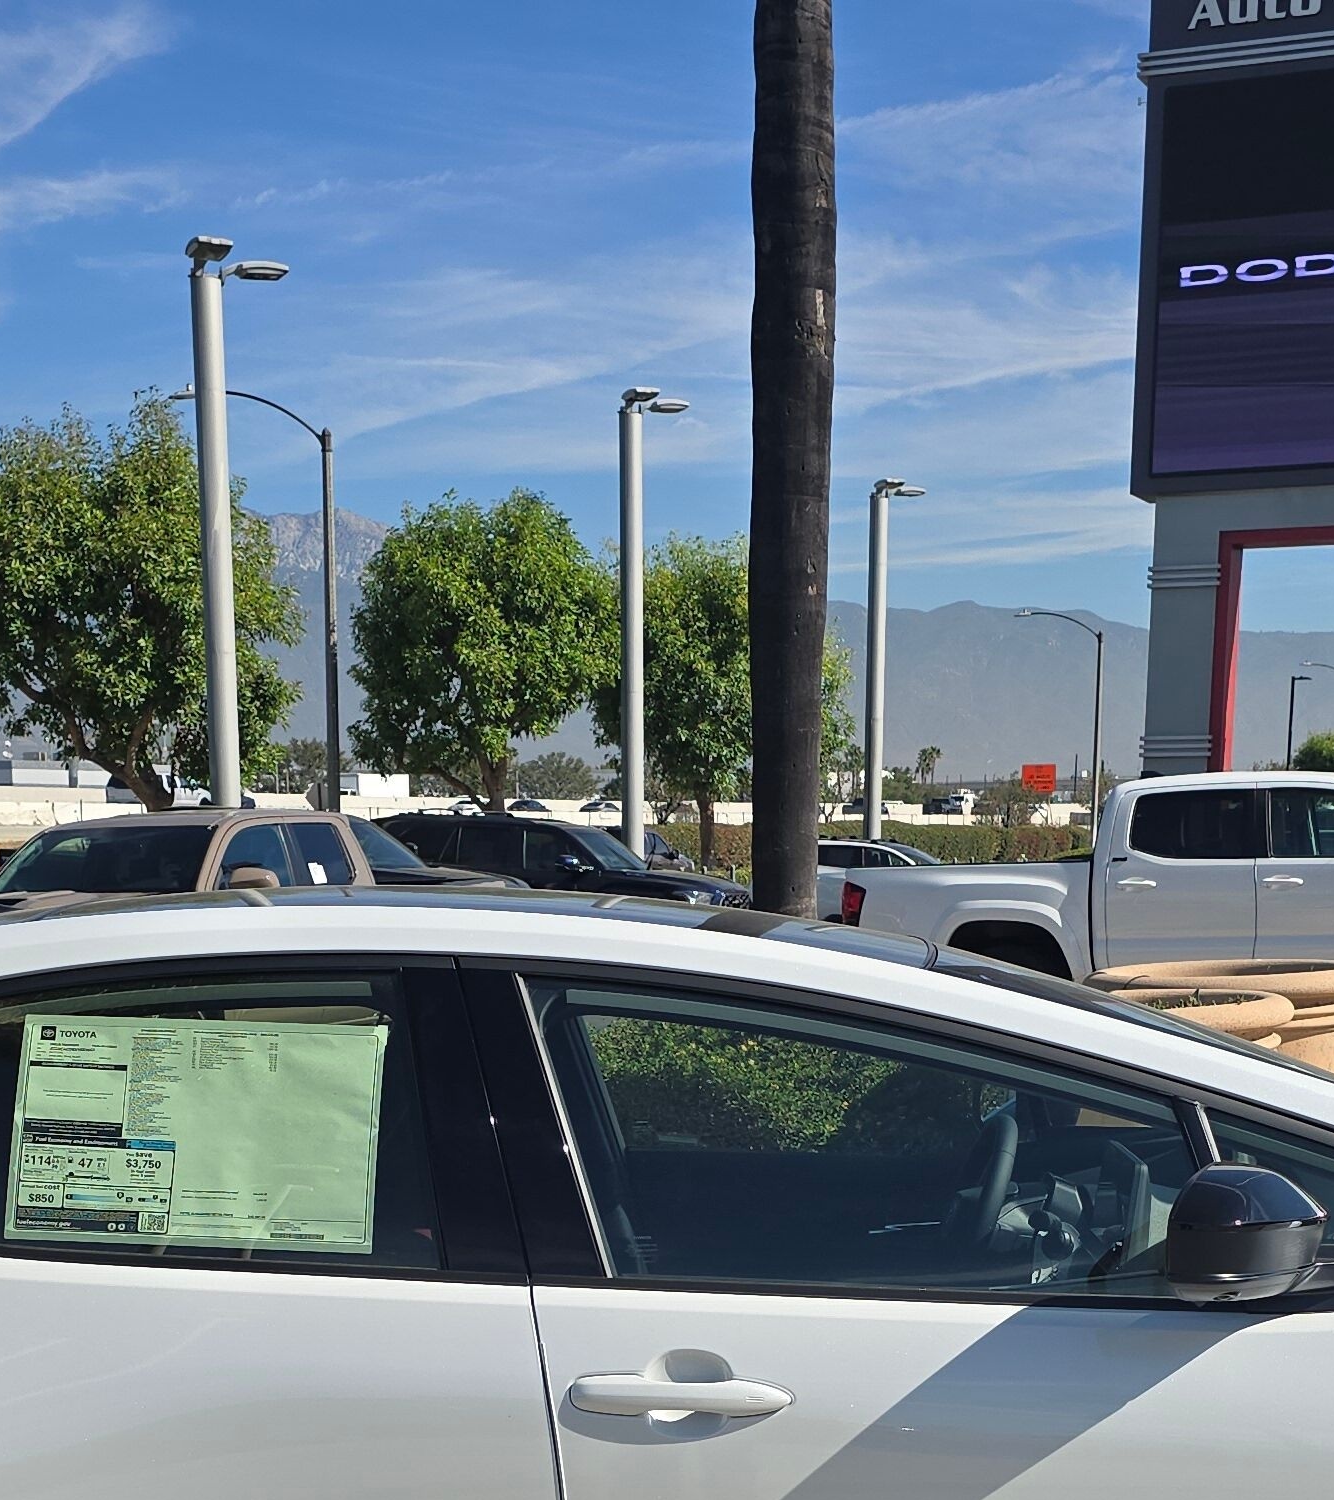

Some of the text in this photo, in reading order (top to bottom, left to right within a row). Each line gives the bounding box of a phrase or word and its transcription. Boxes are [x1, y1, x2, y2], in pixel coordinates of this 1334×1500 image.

[1187, 0, 1321, 30] Auto
[59, 1030, 97, 1039] TOYOTA
[30, 1155, 52, 1166] 114
[78, 1157, 94, 1168] 47
[125, 1158, 162, 1170] $3,750
[27, 1193, 55, 1203] $850
